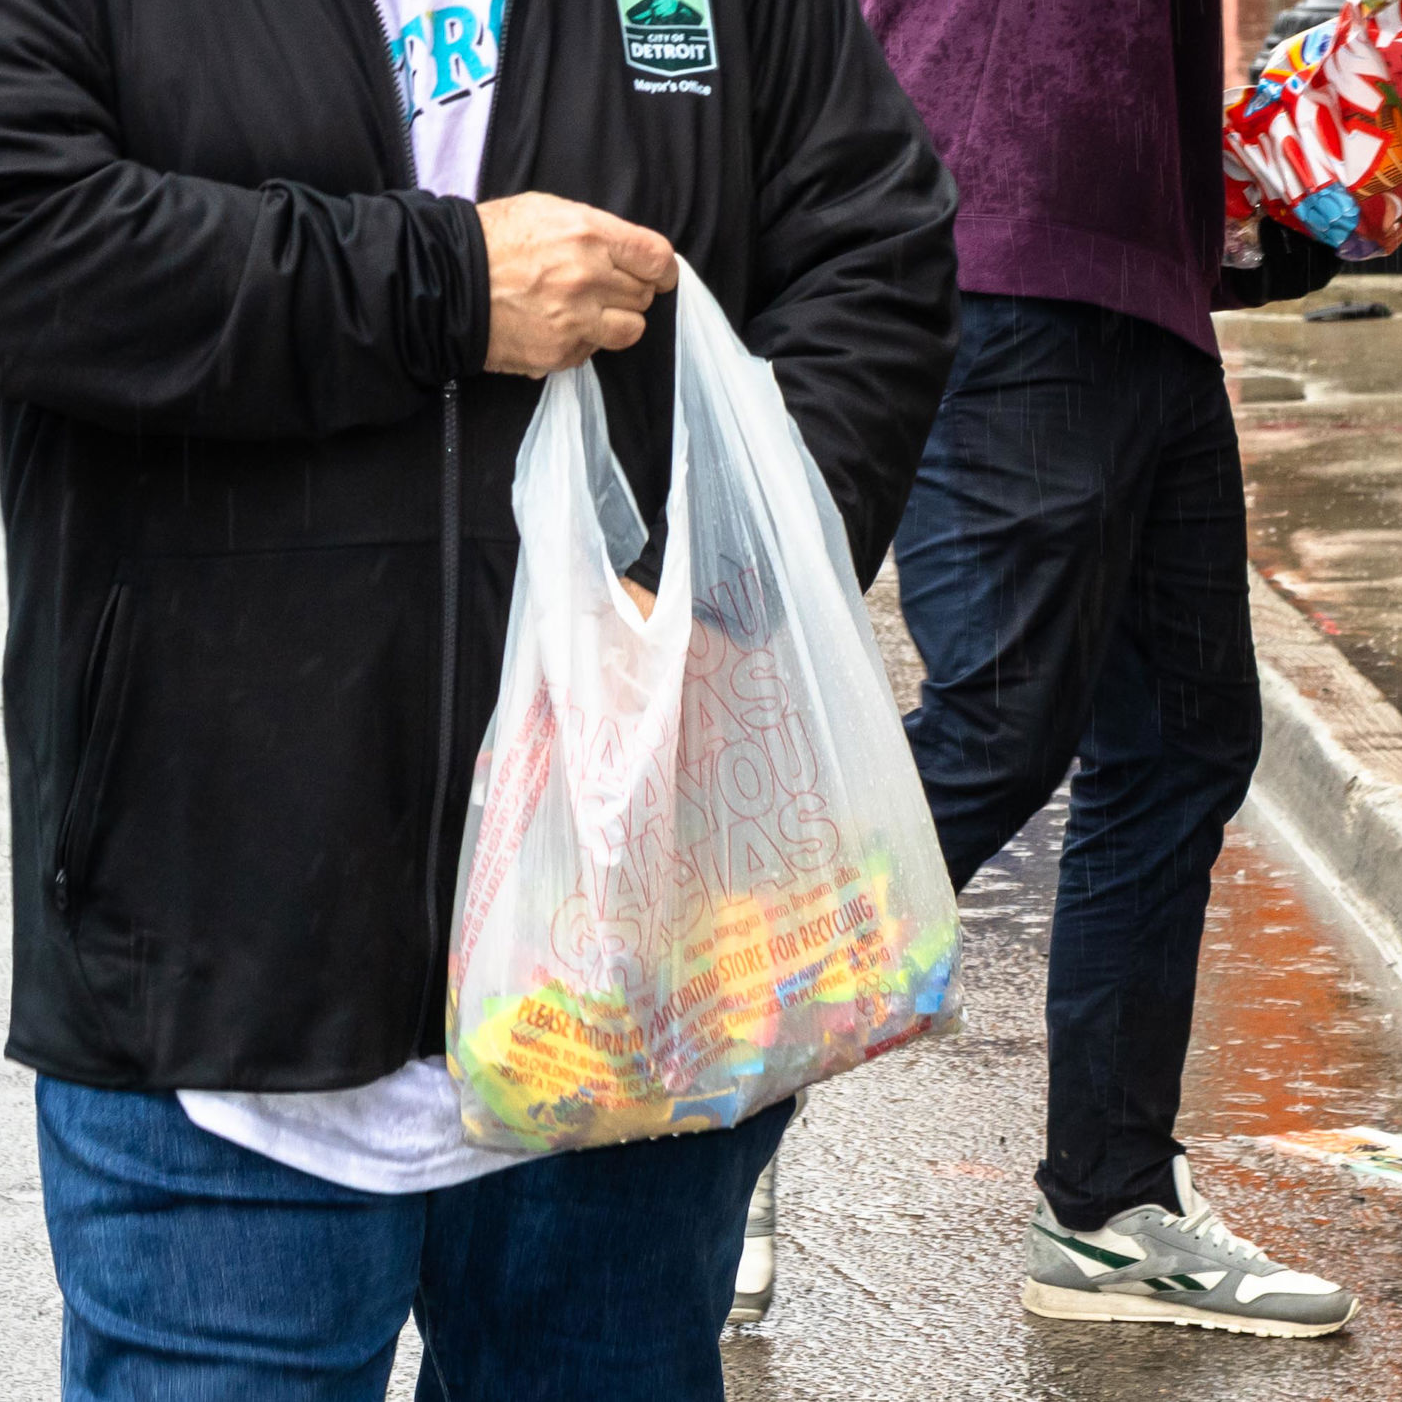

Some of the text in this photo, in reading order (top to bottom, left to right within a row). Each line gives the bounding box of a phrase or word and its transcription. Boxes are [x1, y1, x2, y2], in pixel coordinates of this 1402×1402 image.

[630, 42, 706, 60] DETROIT
[633, 78, 711, 96] Mayor's Office
[517, 994, 571, 1039] PLEASE
[718, 940, 769, 983] STORE
[767, 931, 801, 966] FOR
[799, 893, 874, 951] RECYCLING
